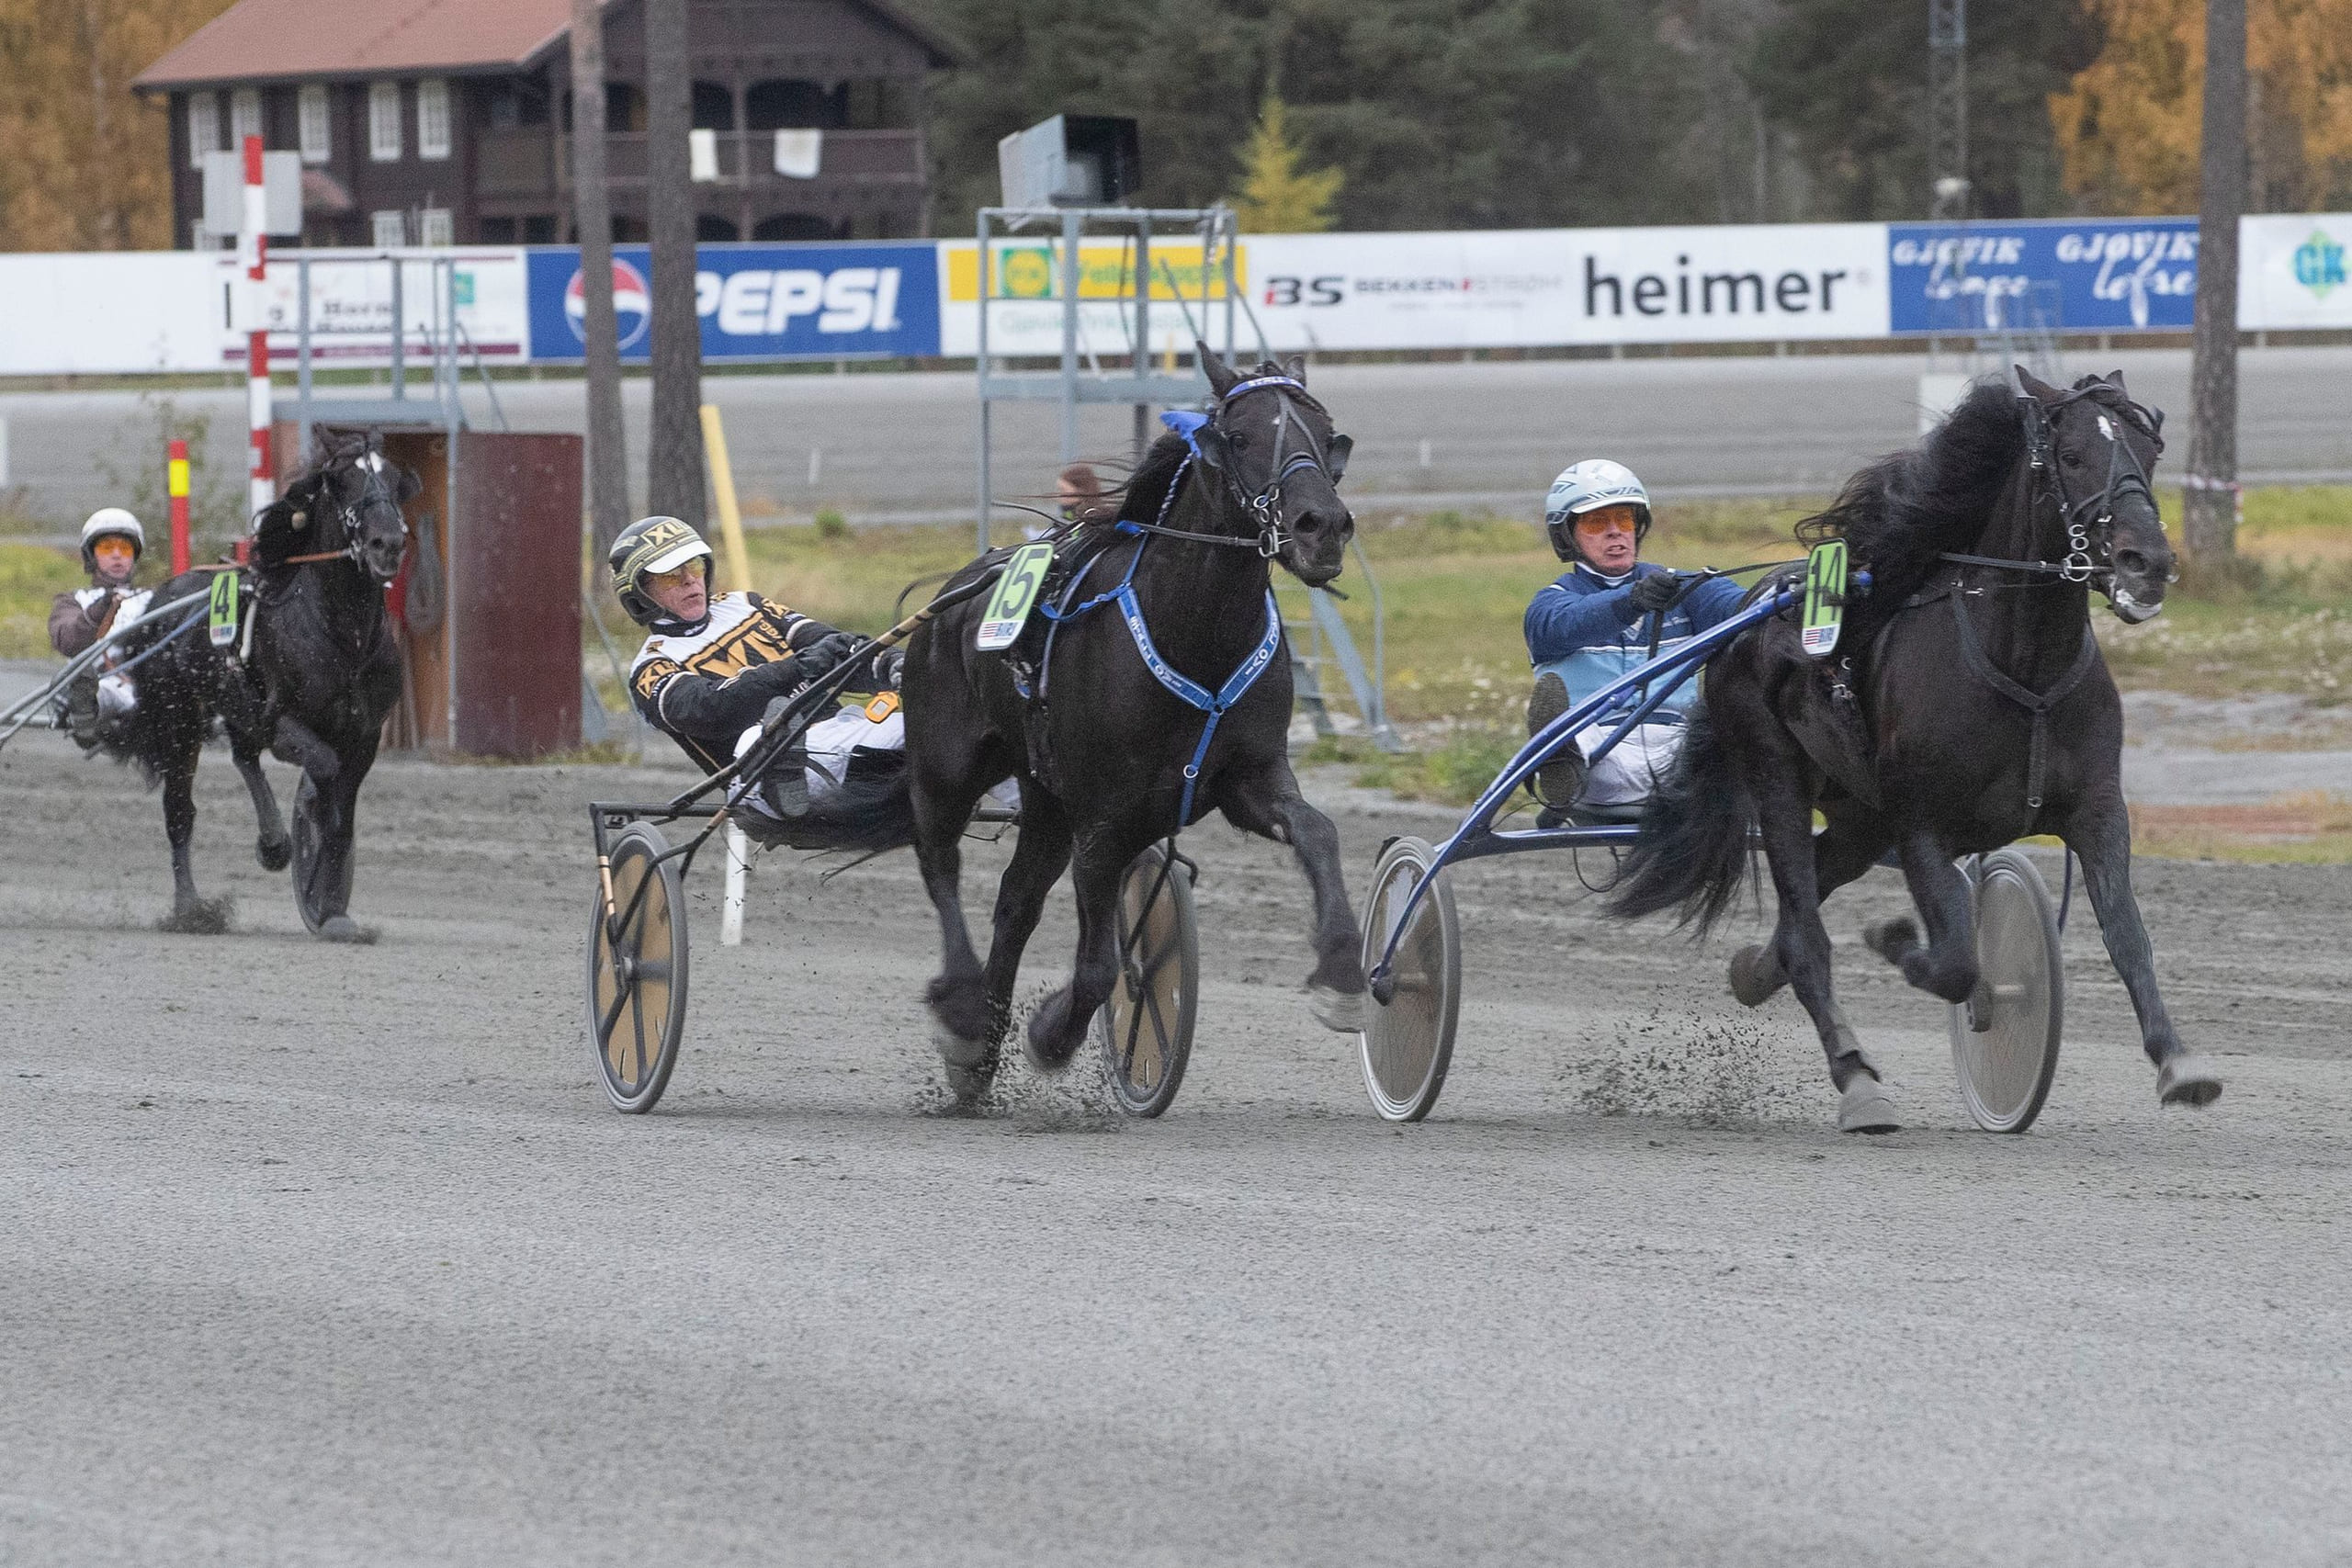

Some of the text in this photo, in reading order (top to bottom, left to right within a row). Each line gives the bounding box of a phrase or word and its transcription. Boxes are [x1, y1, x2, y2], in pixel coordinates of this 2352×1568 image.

[1354, 277, 1456, 293] BEKKEN
[1585, 254, 1846, 316] heimer
[2294, 243, 2346, 287] GK
[695, 267, 900, 335] PEPSI
[214, 575, 231, 623] 4
[991, 547, 1049, 619] 15
[1811, 546, 1845, 626] 14
